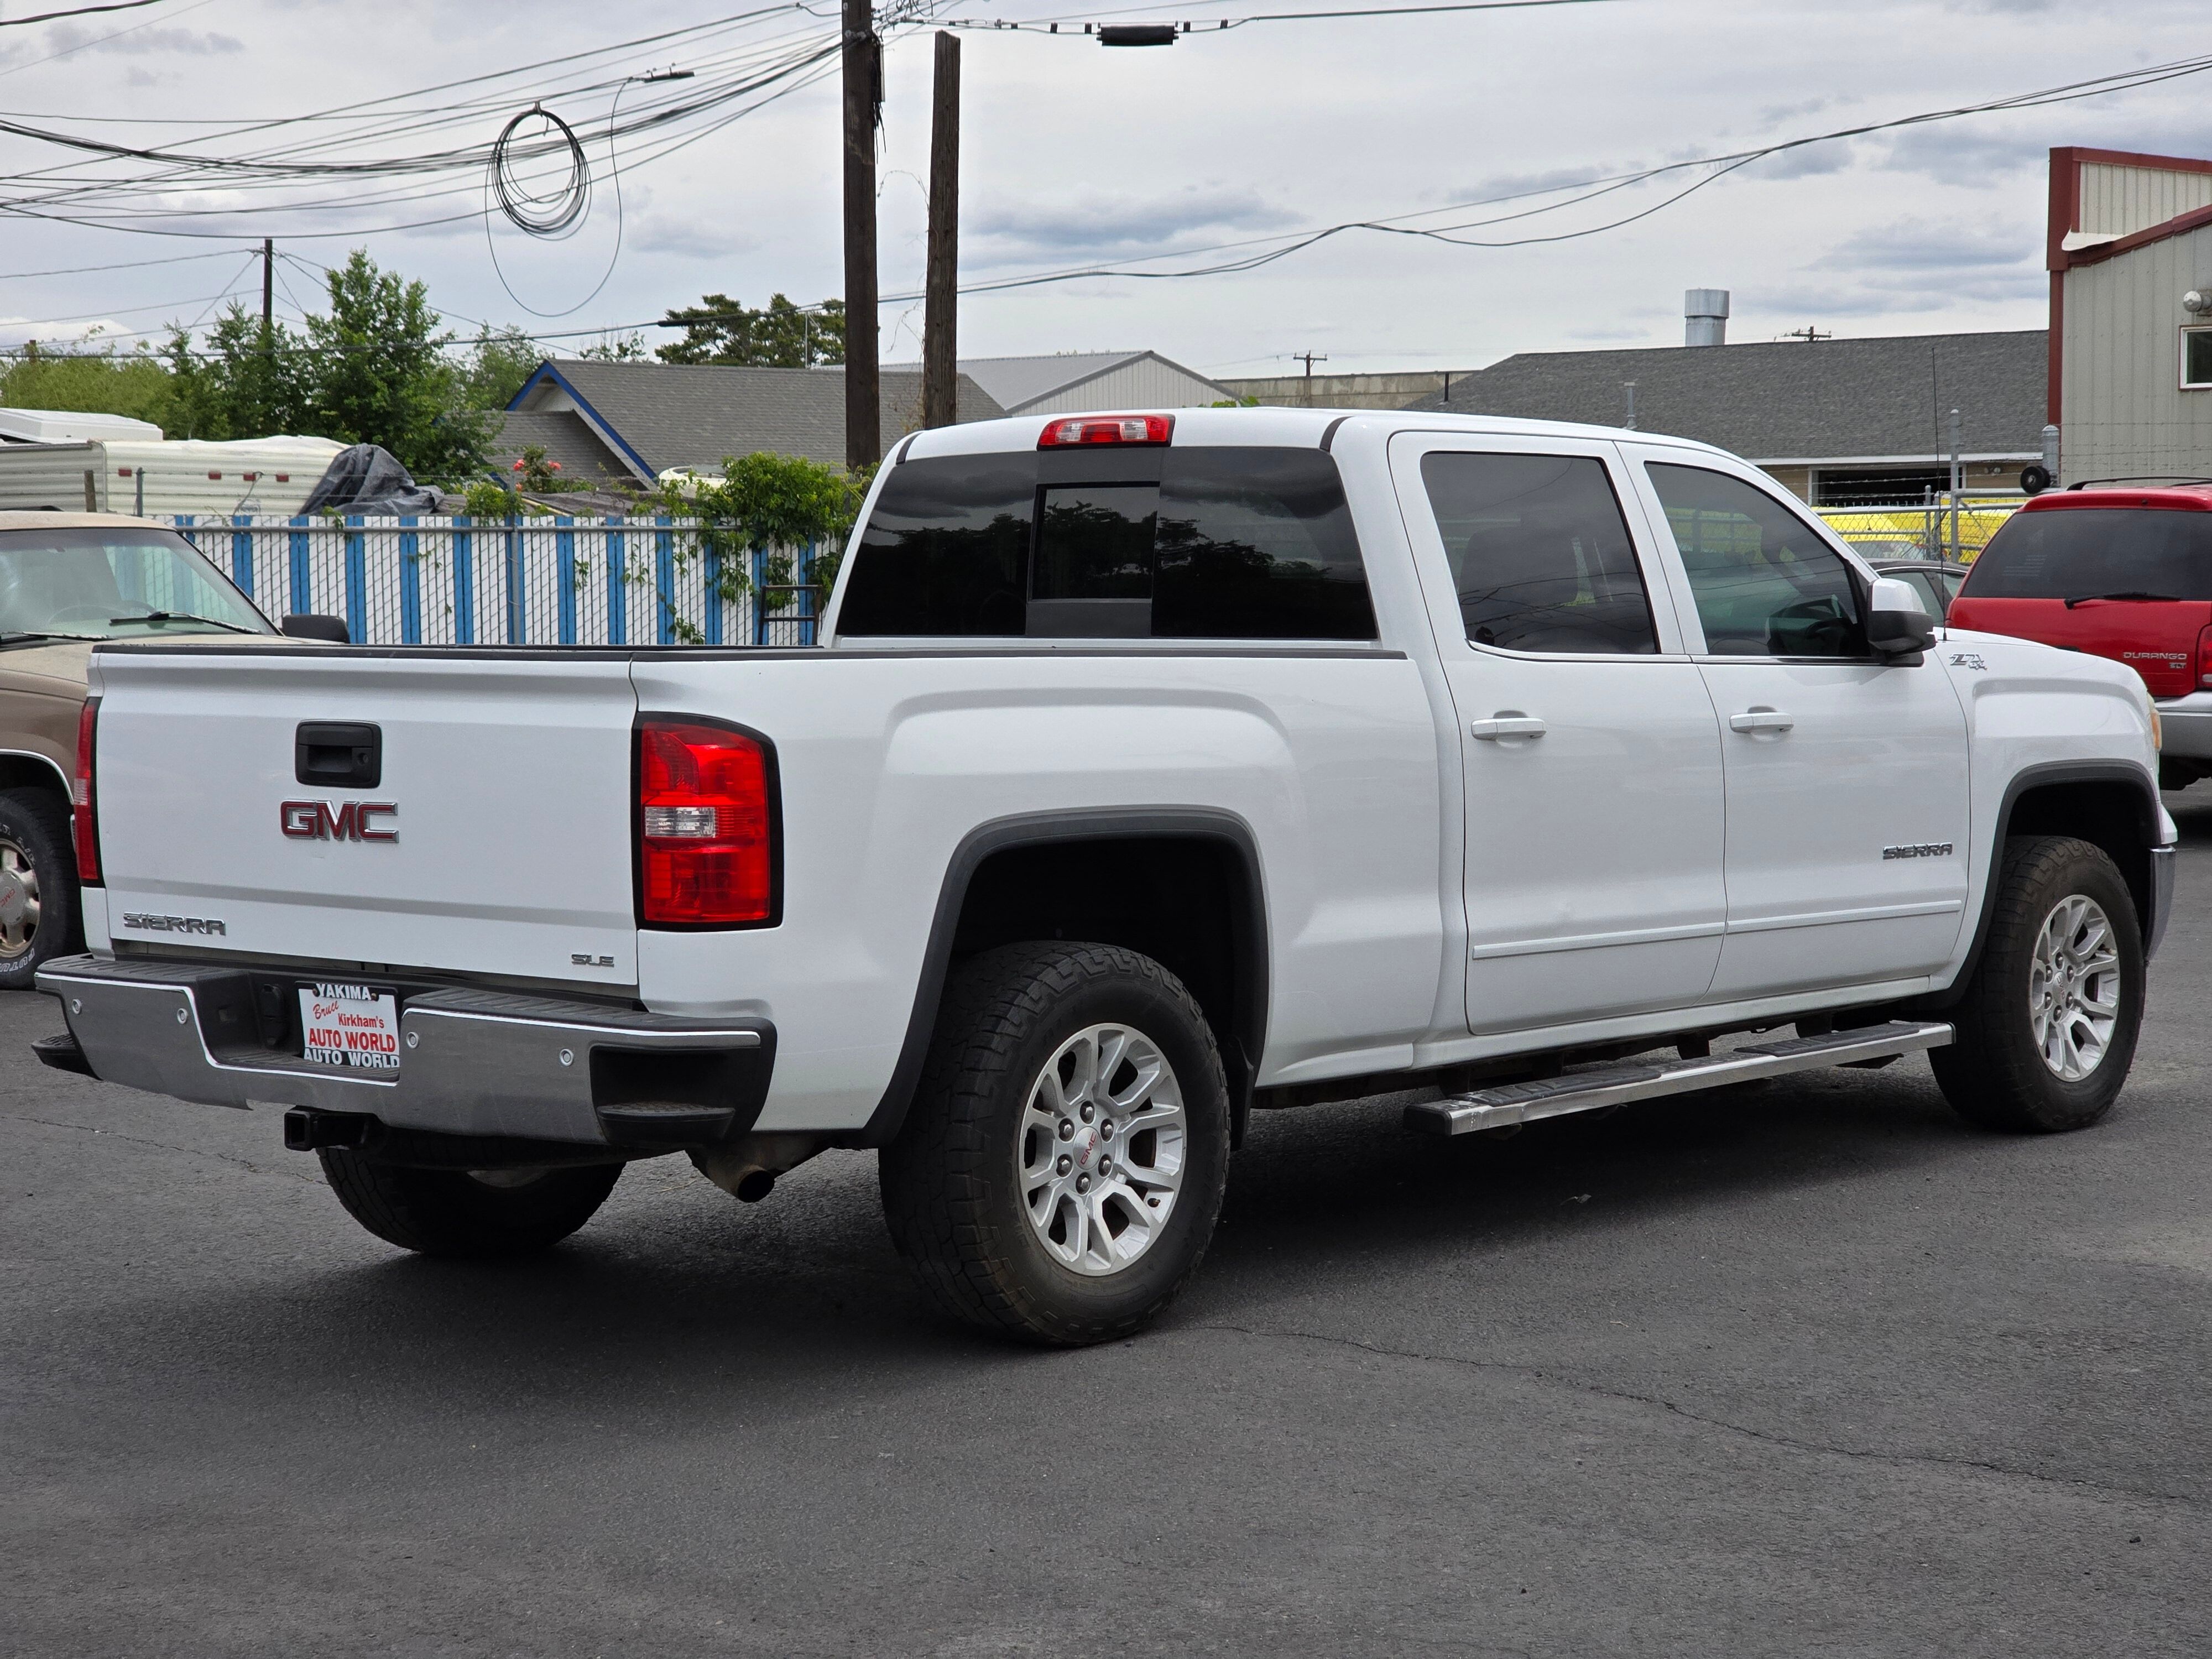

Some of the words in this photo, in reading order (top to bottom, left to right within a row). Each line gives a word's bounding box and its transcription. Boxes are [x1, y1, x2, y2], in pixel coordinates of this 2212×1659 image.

[2123, 651, 2187, 660] DURANGO
[280, 799, 399, 843] GMC
[1883, 842, 1953, 860] SIERRA
[123, 911, 226, 936] SIERRA
[571, 954, 614, 967] SLE
[316, 983, 372, 1000] YAKIMA
[312, 1000, 339, 1019] Bruce
[338, 1013, 384, 1029] Kirkham's
[309, 1028, 342, 1048] AUTO
[345, 1031, 396, 1053] WORLD
[304, 1047, 342, 1065] AUTO
[348, 1052, 400, 1068] WORLD
[1080, 1131, 1097, 1165] GMC
